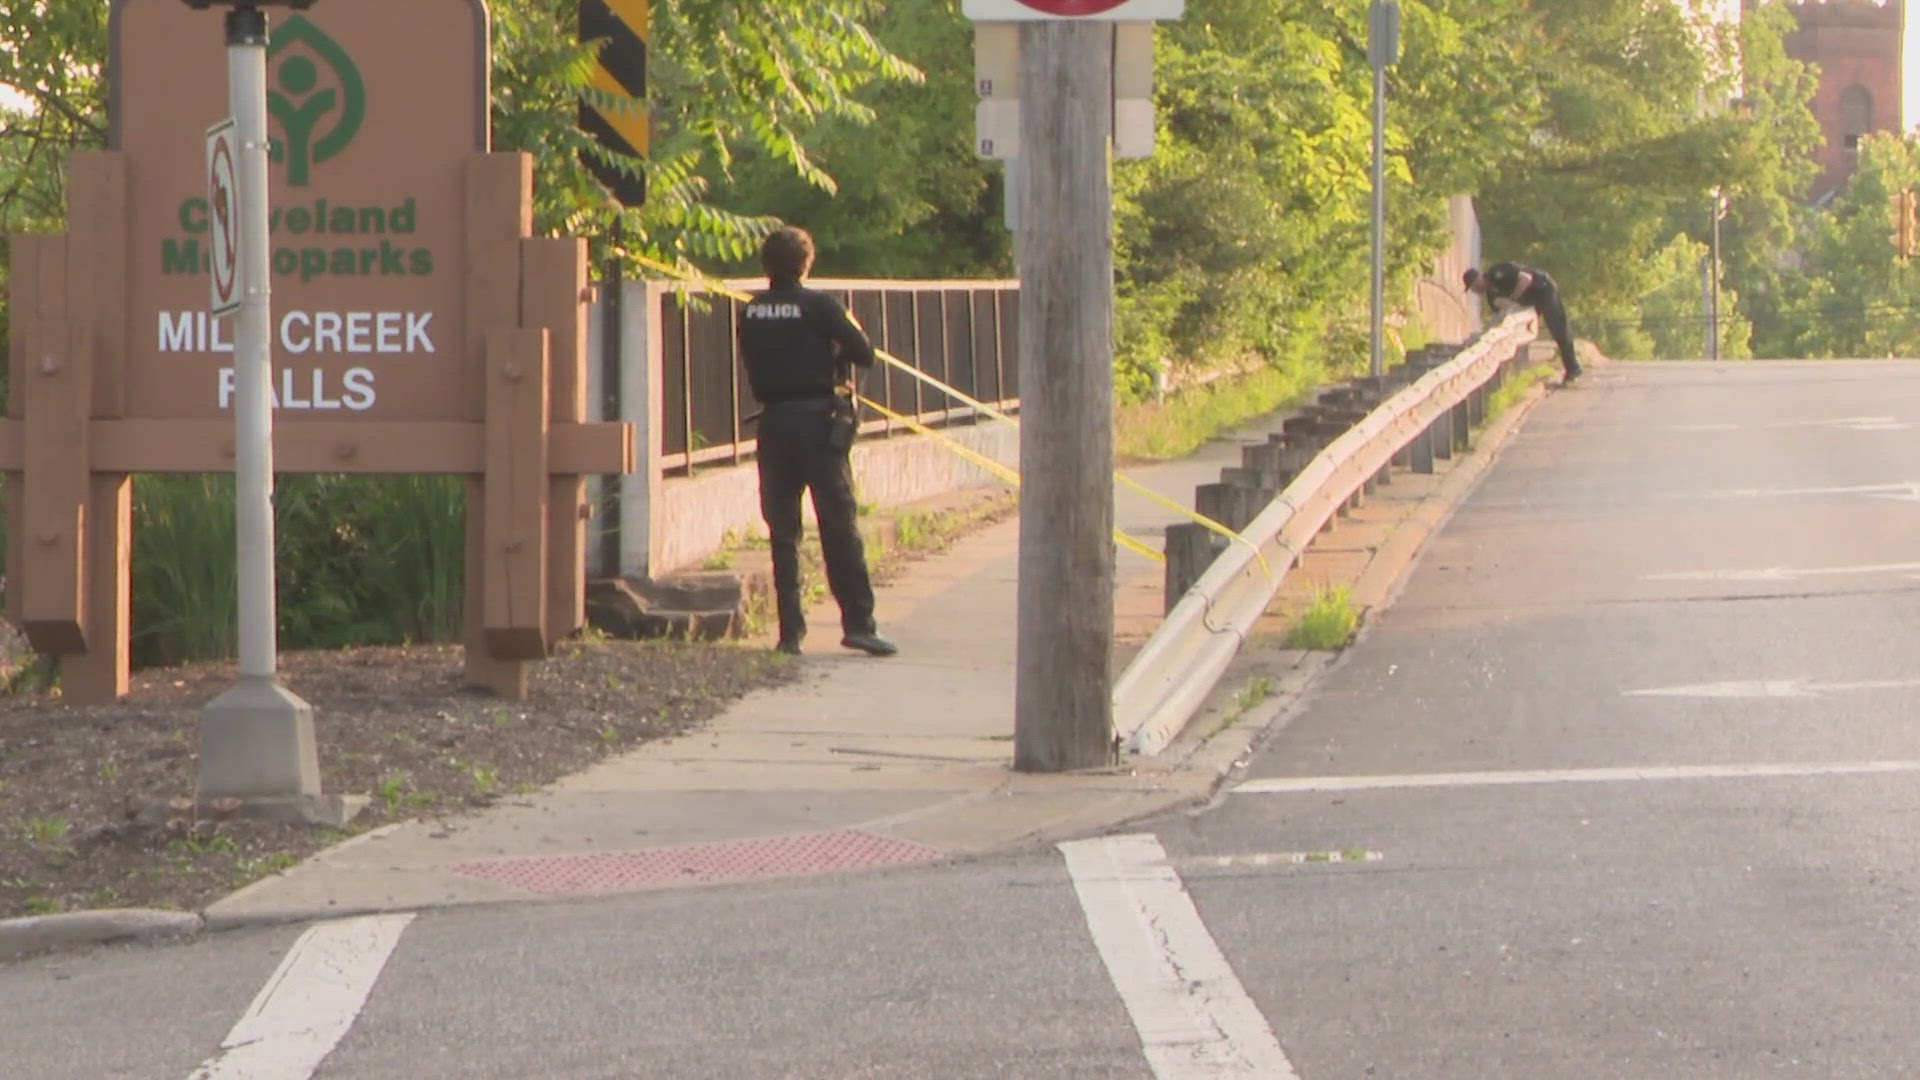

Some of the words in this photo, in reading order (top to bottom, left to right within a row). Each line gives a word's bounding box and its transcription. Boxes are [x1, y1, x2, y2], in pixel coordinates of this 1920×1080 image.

[178, 197, 416, 235] Celand
[161, 238, 434, 283] Moparks
[158, 311, 236, 352] MIL
[280, 310, 435, 353] CREEK
[746, 303, 802, 319] POLICE
[218, 367, 376, 410] FLLS
